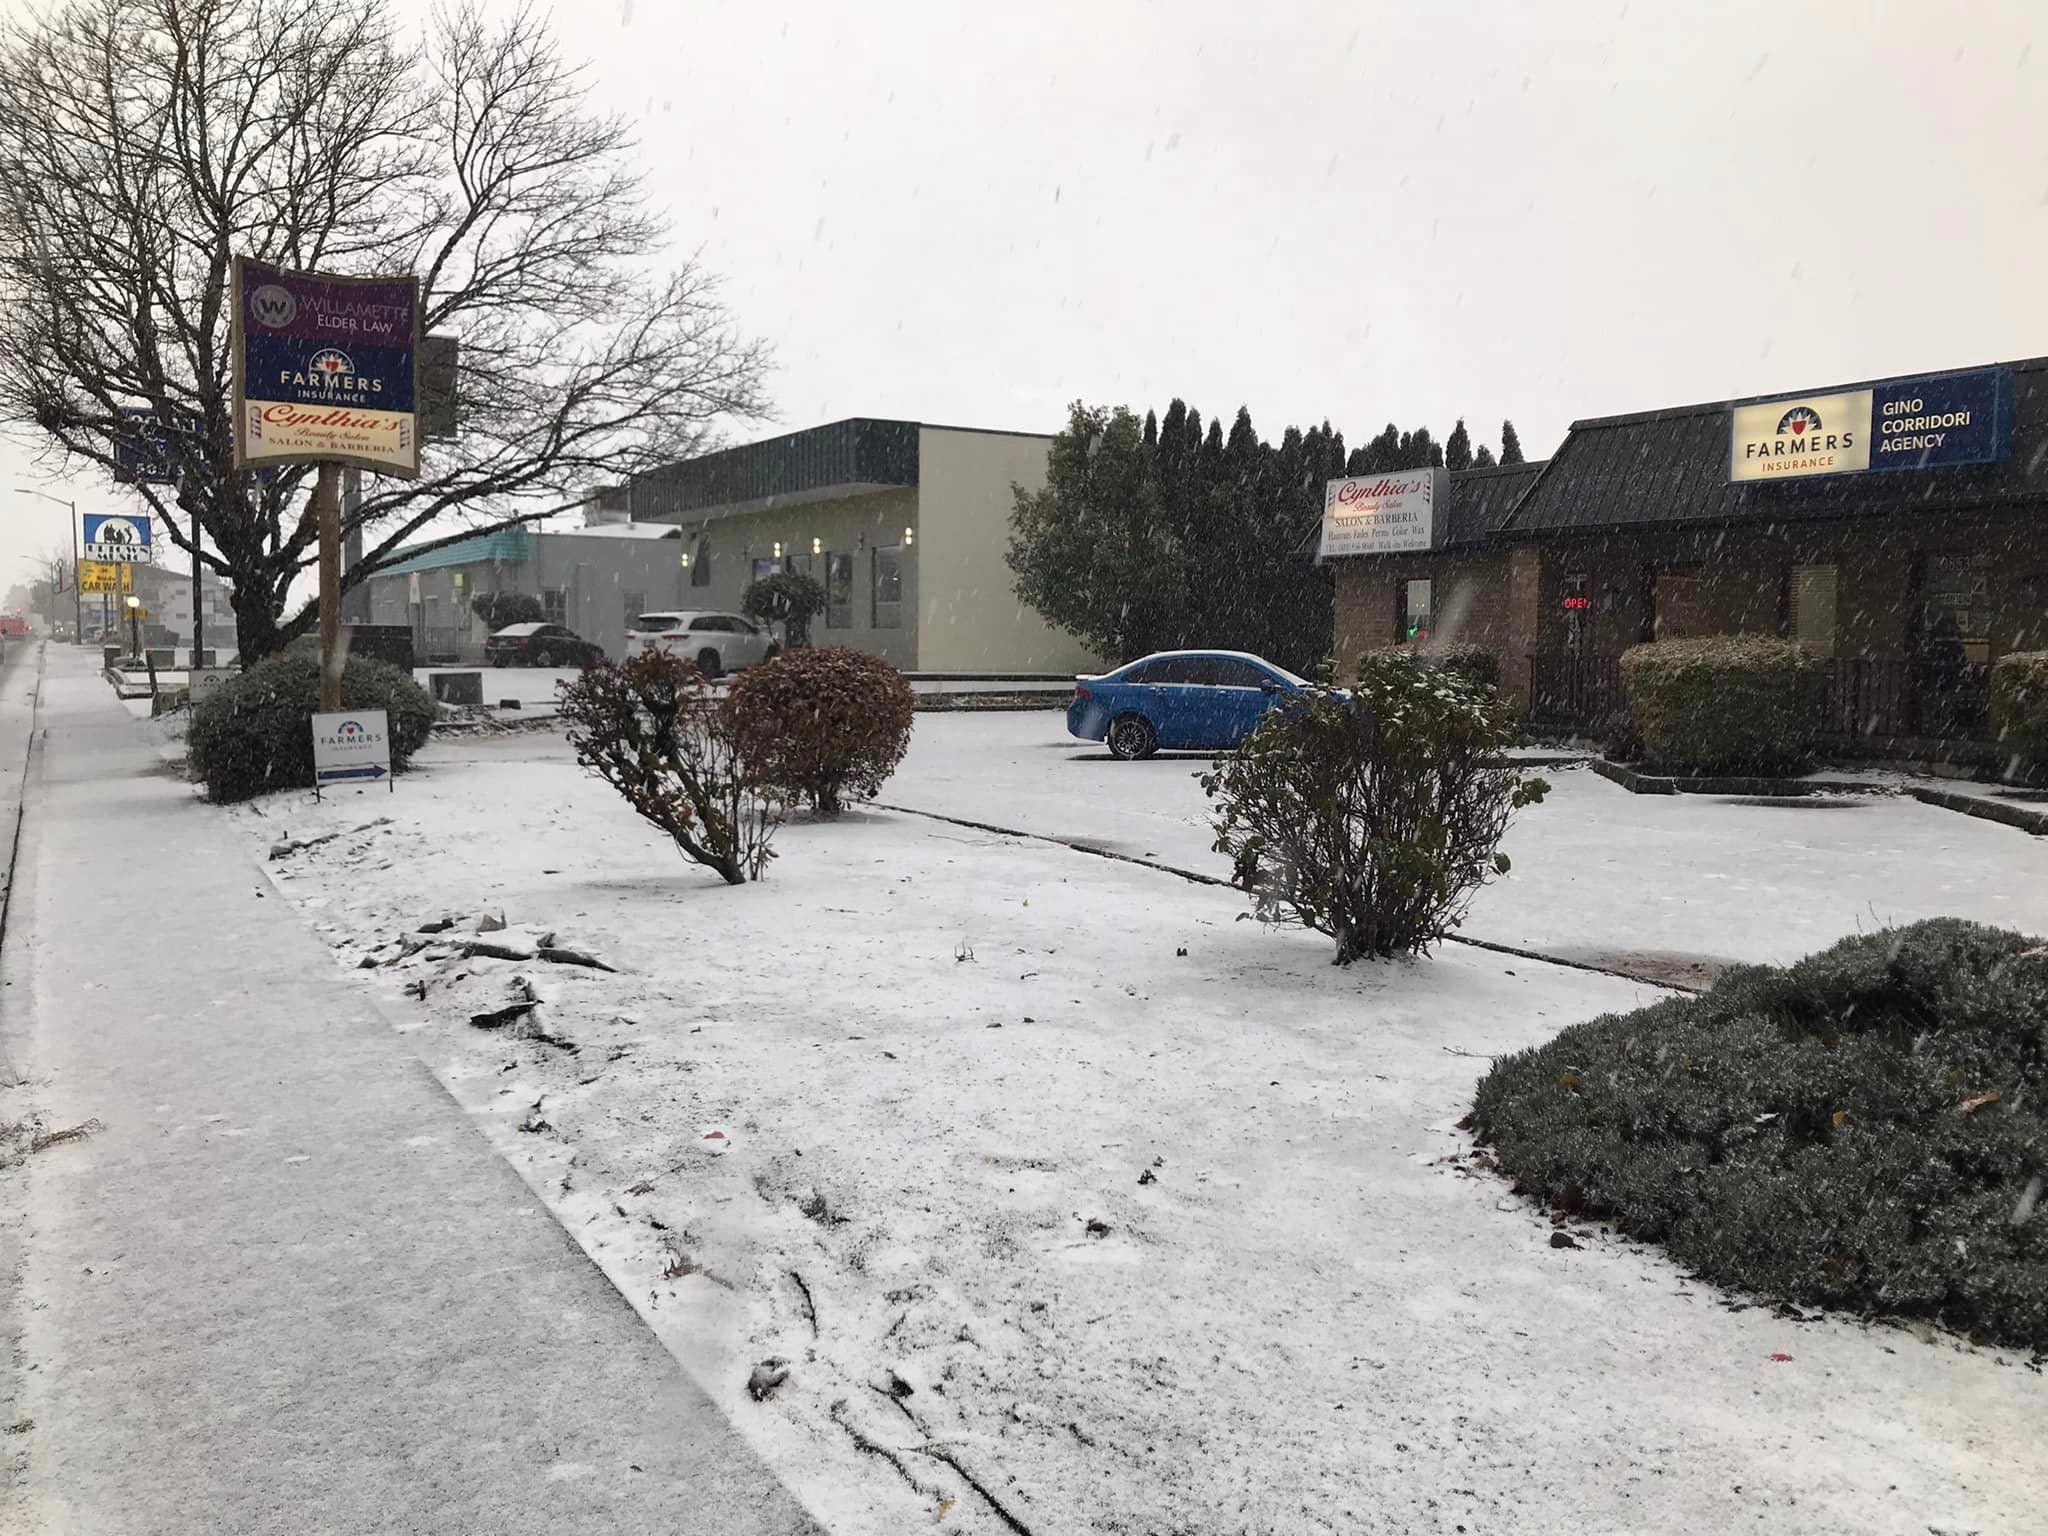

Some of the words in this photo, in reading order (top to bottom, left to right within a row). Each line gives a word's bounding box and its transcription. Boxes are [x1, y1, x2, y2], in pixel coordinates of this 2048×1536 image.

[302, 296, 409, 322] WILLAMETTE
[317, 314, 359, 330] ELDER
[362, 319, 394, 334] LAW
[280, 370, 383, 393] FARMERS
[297, 389, 366, 404] INSURANCE
[1882, 398, 1923, 416] GINO
[263, 404, 400, 431] Cynthia's
[1881, 411, 1971, 435] CORRIDORI
[268, 436, 313, 448] SALON
[316, 441, 326, 449] &
[330, 441, 395, 454] BARBERIA
[1746, 432, 1853, 459] FARMERS
[1880, 433, 1946, 453] AGENCY
[1762, 456, 1834, 473] INSURANCE
[1338, 479, 1422, 506] Cynthia's
[1335, 516, 1363, 528] SALON
[1364, 517, 1372, 525] &
[1374, 512, 1419, 525] BARBERIA
[82, 581, 101, 591] CAR
[103, 582, 130, 592] WAH
[321, 734, 382, 745] FARMERS
